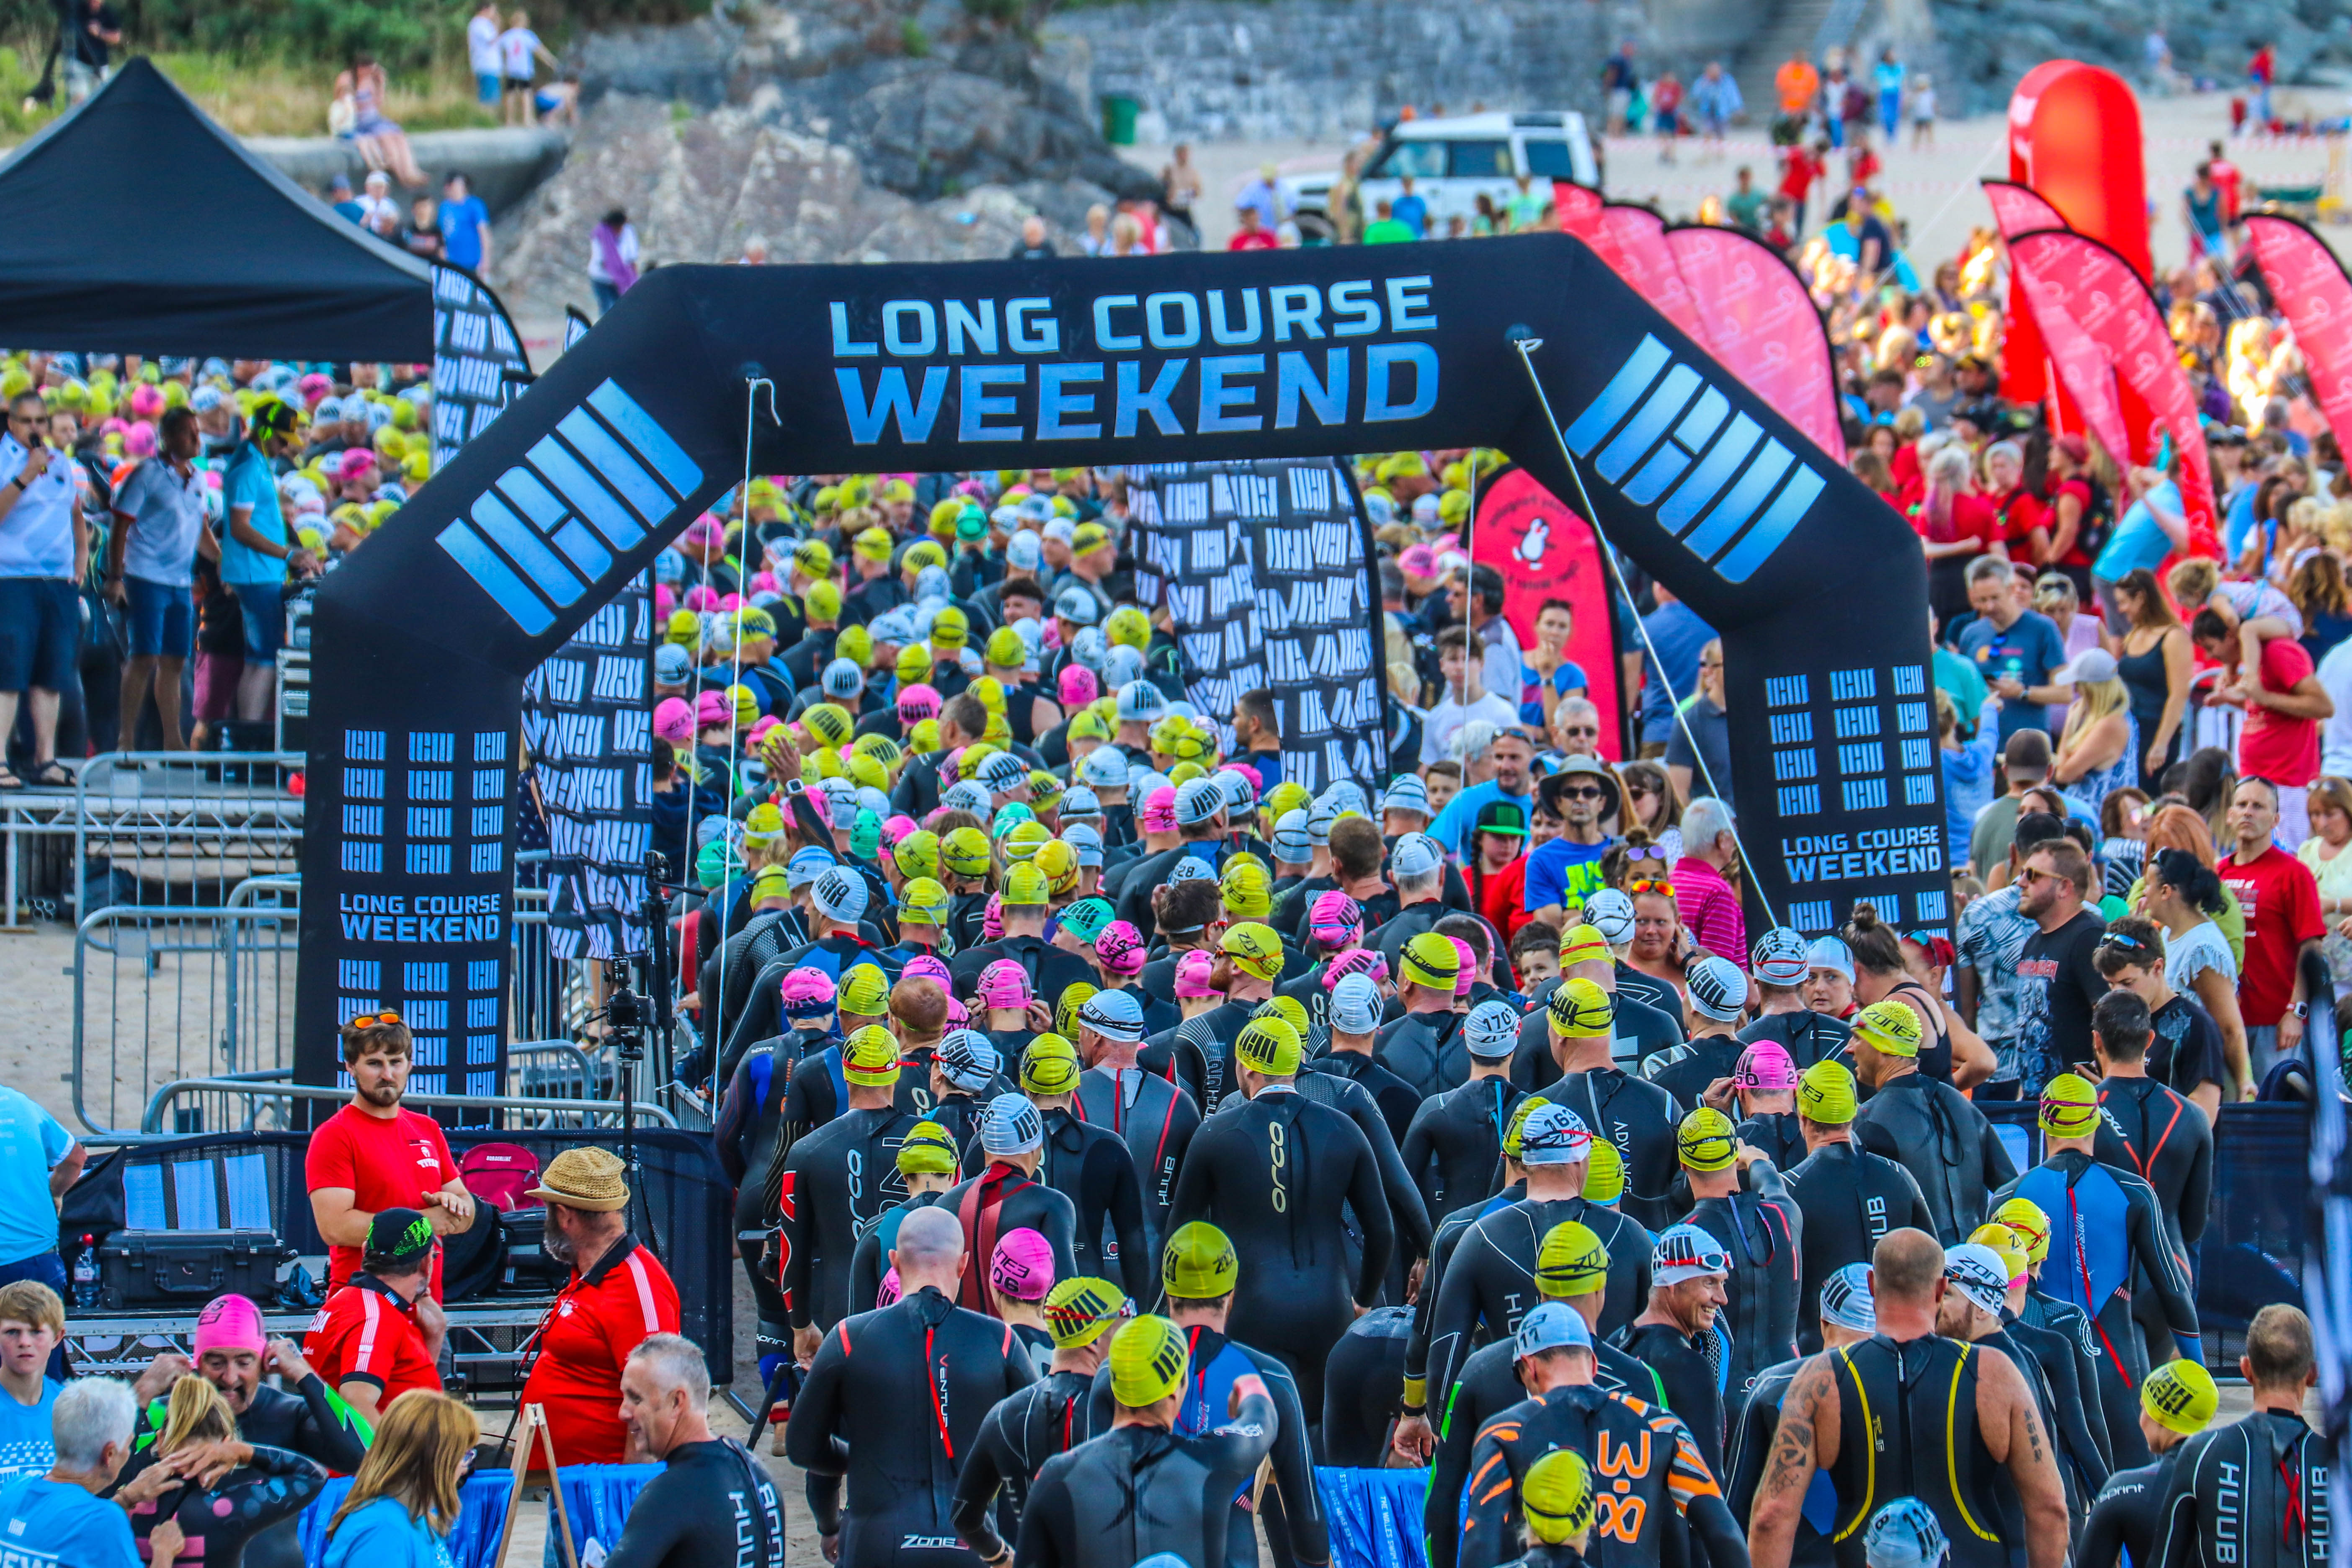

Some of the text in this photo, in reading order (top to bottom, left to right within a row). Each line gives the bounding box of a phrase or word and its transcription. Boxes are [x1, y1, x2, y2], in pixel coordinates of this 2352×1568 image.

[830, 275, 1437, 357] LONG COURSE
[834, 340, 1439, 446] WEEKEND
[1782, 825, 1939, 857] LONG COURSE
[1785, 846, 1942, 883] WEEKEND
[340, 893, 500, 915] LONG COURSE
[340, 914, 500, 943] WEEKEND
[1880, 1004, 1915, 1028] 628
[1158, 1156, 1175, 1206] HUUB
[1269, 1121, 1286, 1213] orca
[848, 1149, 866, 1241] orca
[727, 1491, 755, 1568] HUU
[1382, 1512, 1393, 1538] WALES
[2215, 1461, 2240, 1563] HUUB
[1387, 1540, 1398, 1560] SWIM
